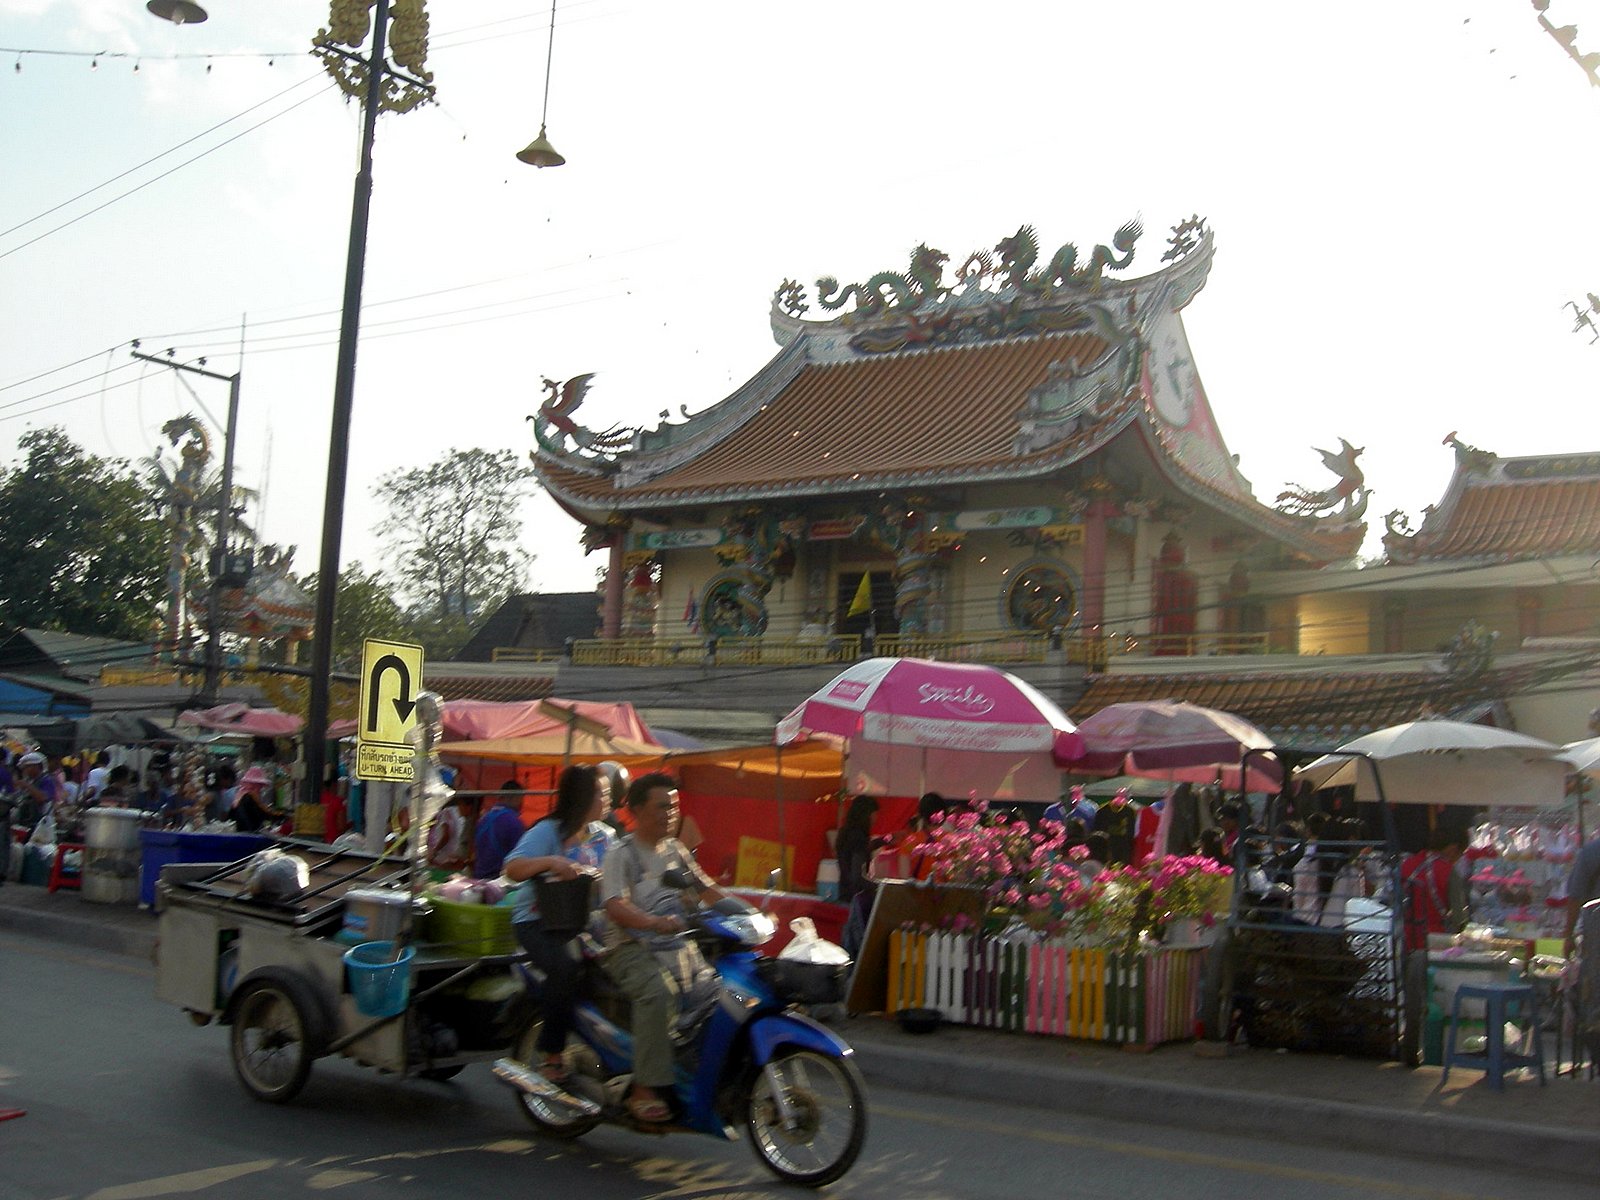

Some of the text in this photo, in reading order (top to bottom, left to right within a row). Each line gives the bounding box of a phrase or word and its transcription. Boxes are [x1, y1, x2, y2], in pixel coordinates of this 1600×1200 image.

[918, 682, 990, 707] Smile
[361, 763, 413, 776] U-TURN AHEAD
